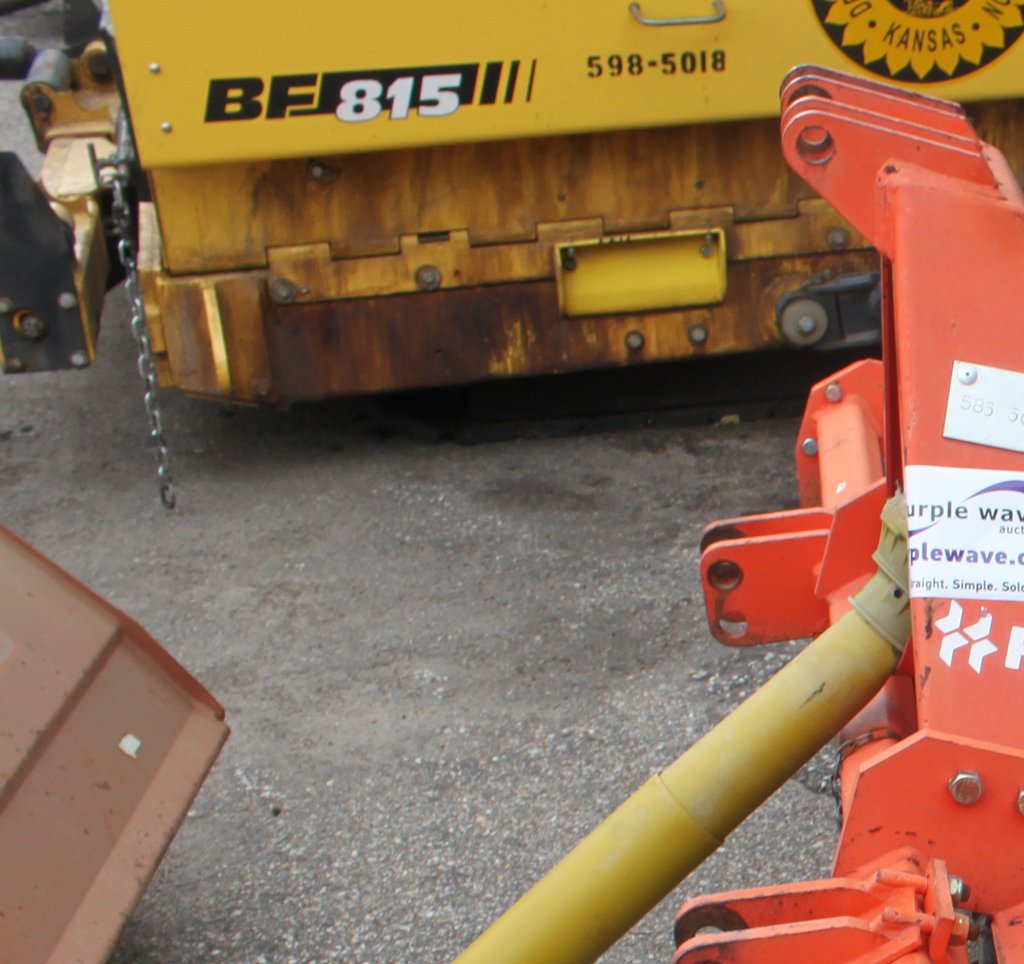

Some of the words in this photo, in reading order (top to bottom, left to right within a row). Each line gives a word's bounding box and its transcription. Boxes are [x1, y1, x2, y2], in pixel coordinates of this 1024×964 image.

[883, 22, 967, 52] KANSAS
[586, 50, 727, 79] 598-5018
[335, 73, 463, 123] 815
[960, 395, 994, 417] 585
[952, 579, 998, 593] Simple.
